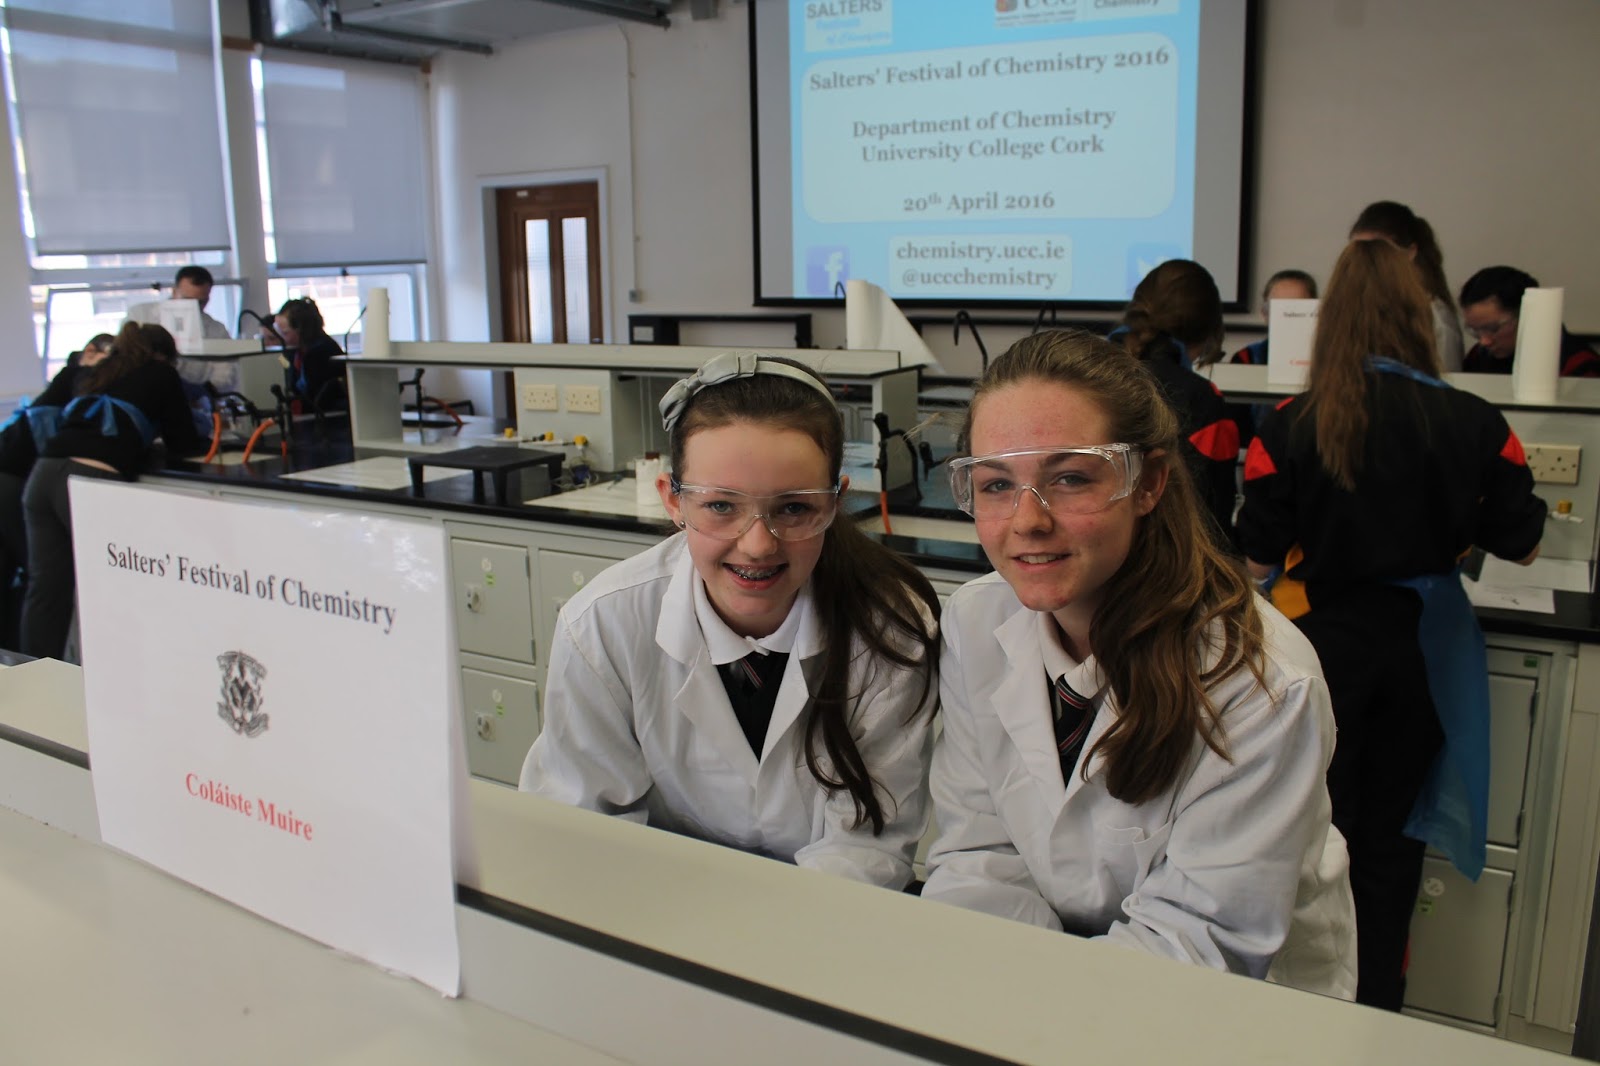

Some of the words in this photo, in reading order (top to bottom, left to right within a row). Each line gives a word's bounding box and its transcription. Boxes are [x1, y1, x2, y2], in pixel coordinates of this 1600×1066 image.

[809, 67, 880, 91] Salters'
[886, 60, 962, 84] Festival
[968, 57, 991, 77] of
[993, 51, 1106, 74] Chemistry
[1113, 45, 1169, 68] 2016
[853, 115, 971, 141] Department
[976, 110, 999, 130] of
[1001, 107, 1116, 130] Chemistry
[862, 141, 962, 163] University
[968, 137, 1045, 160] College
[1050, 133, 1105, 154] Cork
[903, 192, 942, 212] 20th
[947, 191, 998, 215] April
[1004, 192, 1055, 210] 2016
[896, 240, 1065, 263] chemistry.ucc.ie
[902, 267, 1057, 290] @uccchemistry
[107, 542, 171, 577] Salters’
[177, 556, 250, 596] Festival
[256, 574, 276, 600] of
[281, 577, 396, 635] Chemistry
[185, 773, 253, 817] Coláiste
[258, 798, 313, 841] Muire
